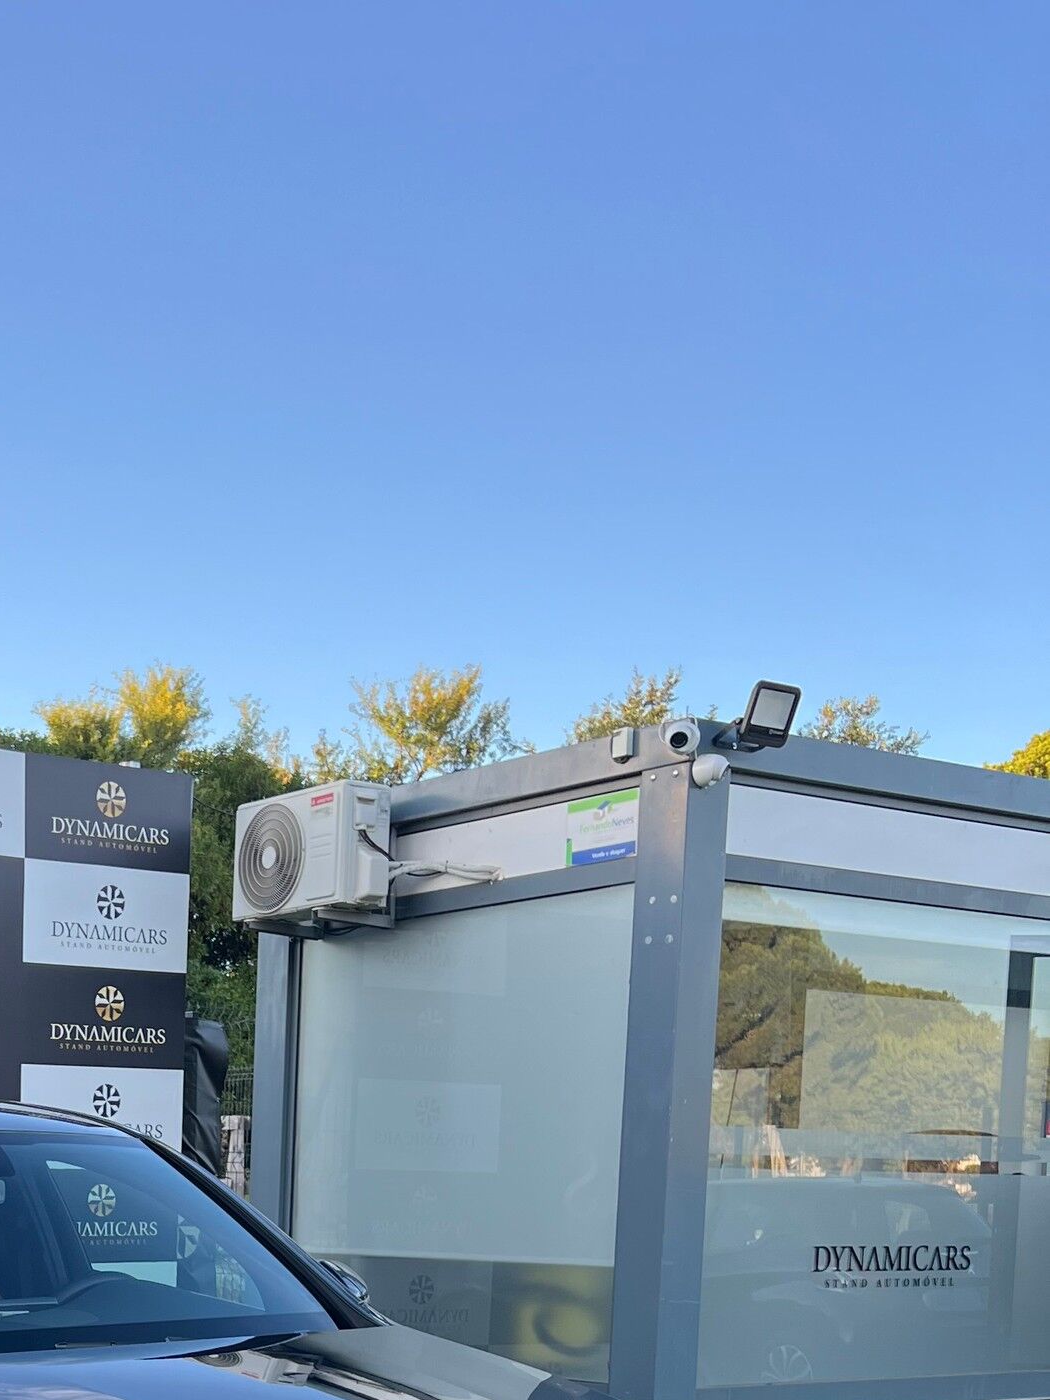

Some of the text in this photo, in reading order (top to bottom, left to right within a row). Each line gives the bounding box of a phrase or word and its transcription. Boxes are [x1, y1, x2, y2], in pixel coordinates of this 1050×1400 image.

[51, 816, 170, 845] DYNAMICARS
[61, 837, 93, 847] STAND
[51, 921, 167, 945] DYNAMICARS
[61, 941, 92, 949] STAND
[50, 1023, 166, 1045] DYNAMICARS
[59, 1043, 91, 1051] STAND
[812, 1245, 971, 1272] DYNAMICARS
[824, 1276, 955, 1289] STAND AUTOMÓVEL
